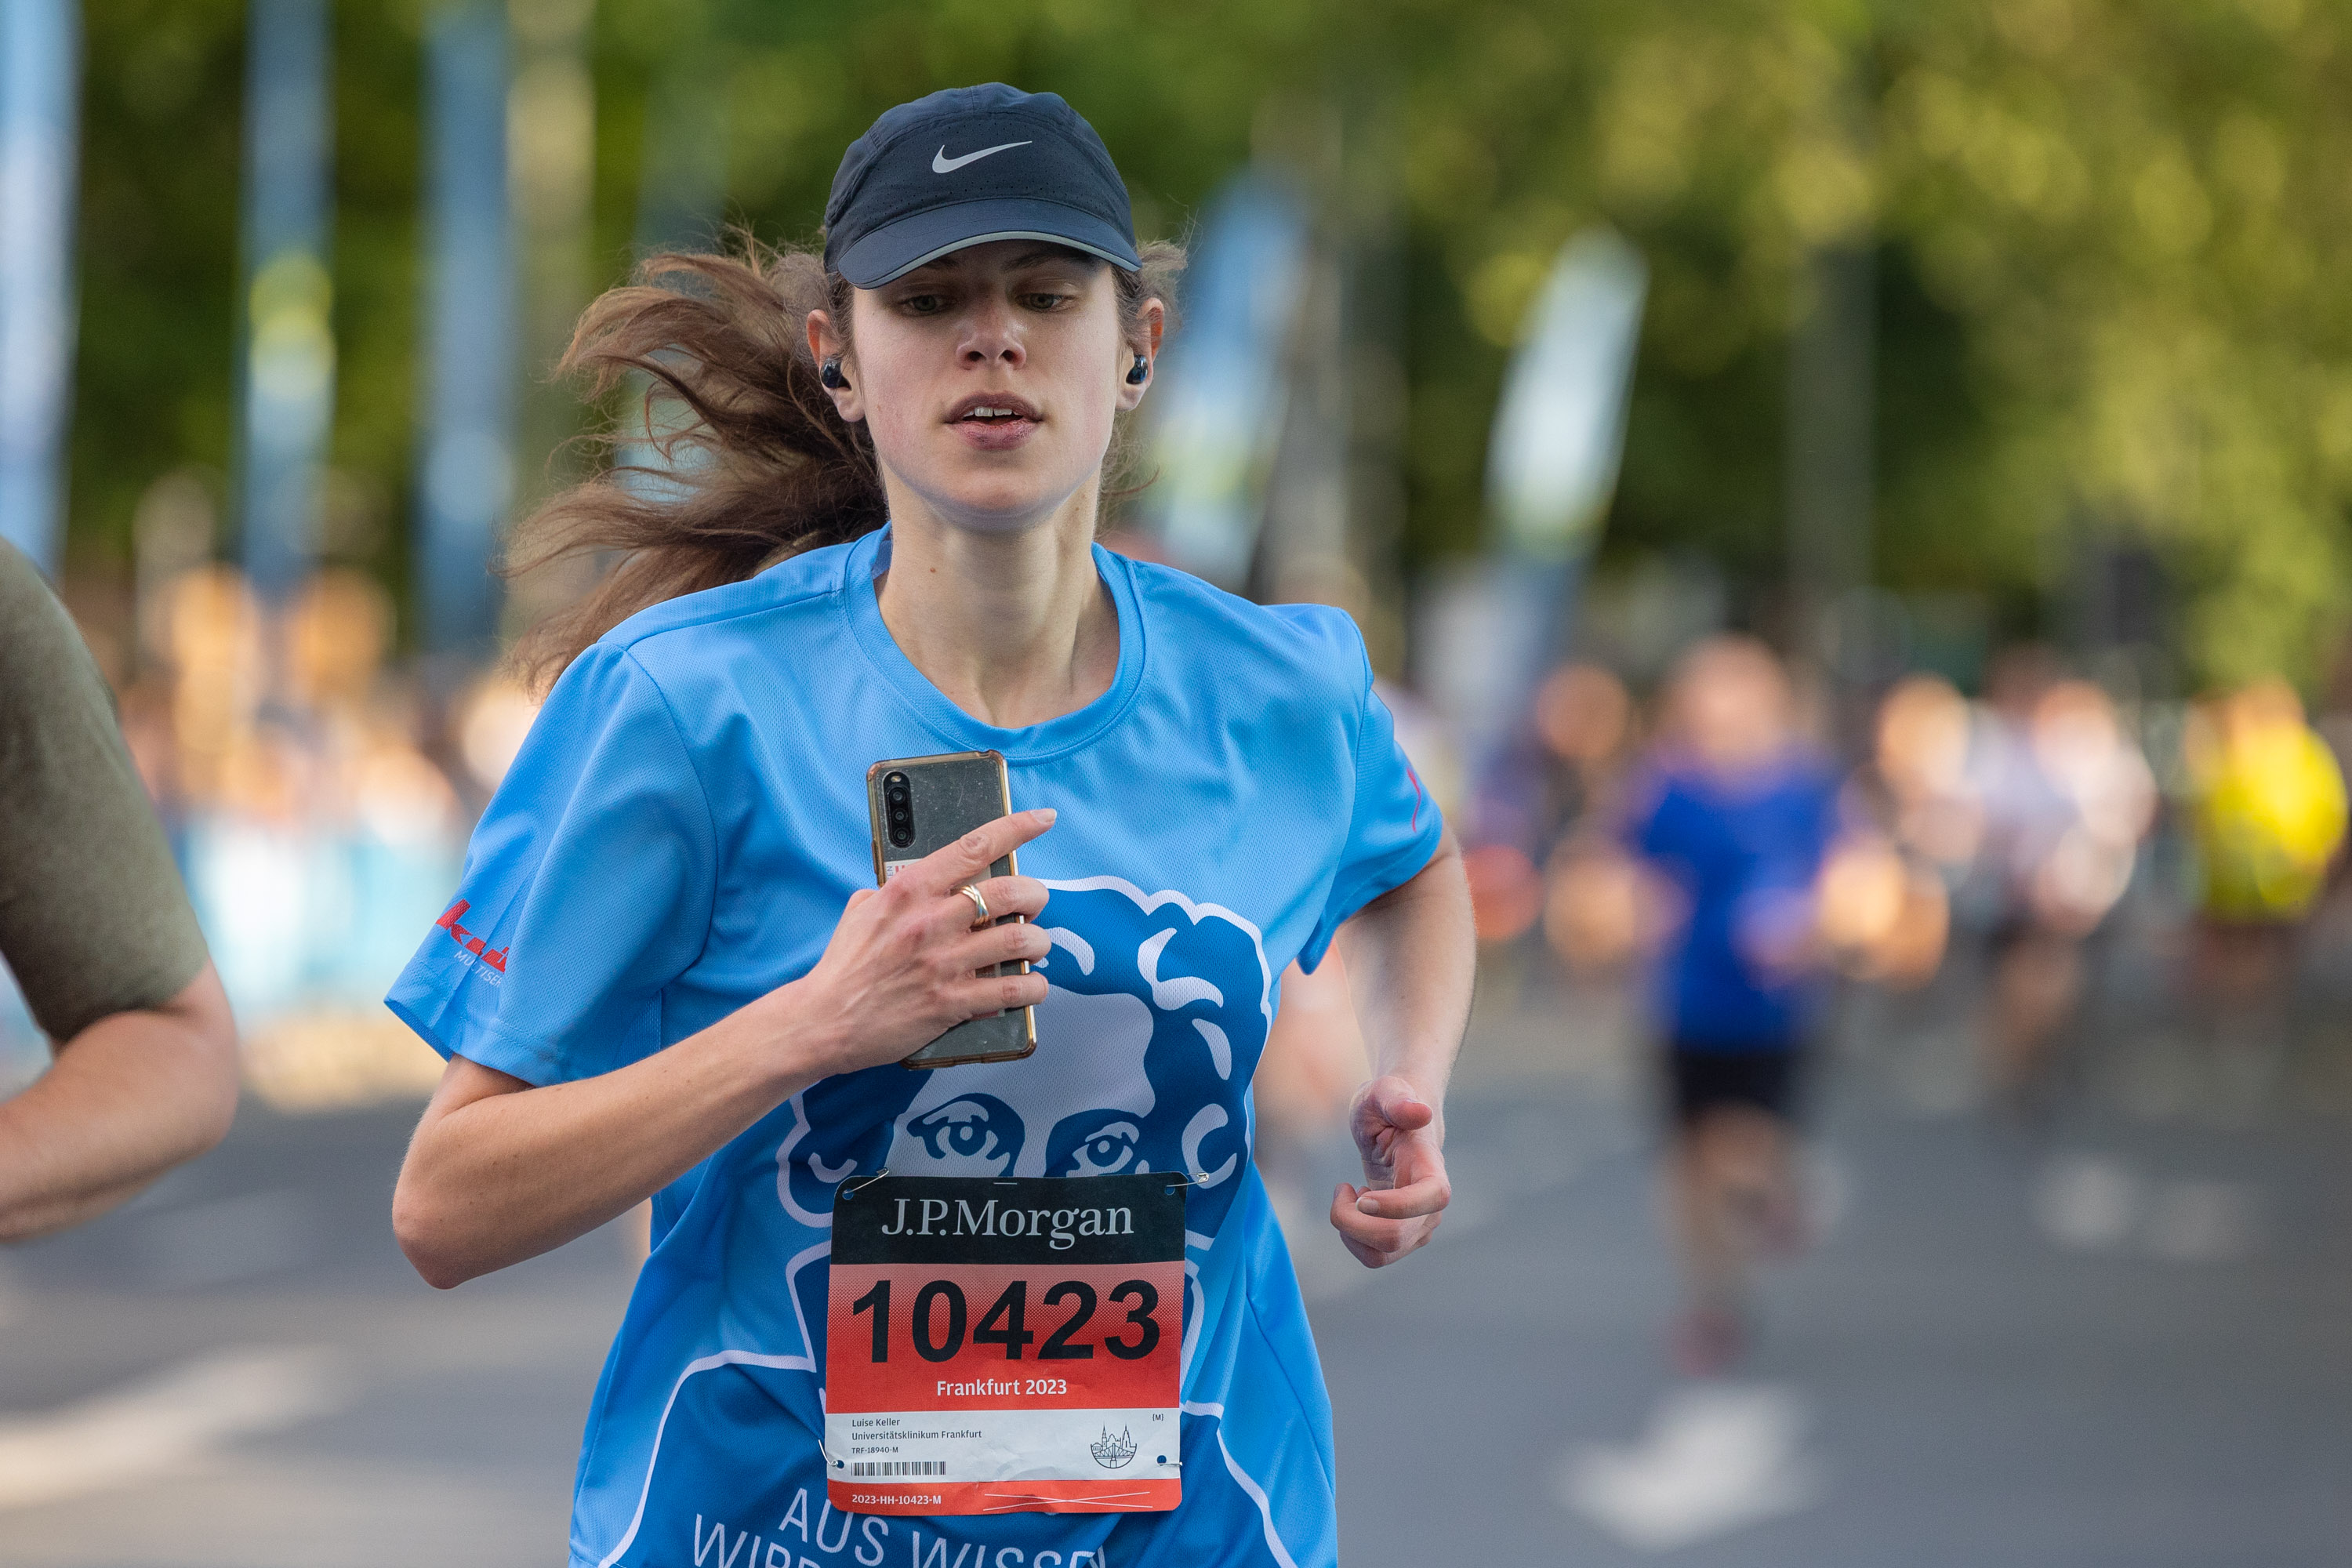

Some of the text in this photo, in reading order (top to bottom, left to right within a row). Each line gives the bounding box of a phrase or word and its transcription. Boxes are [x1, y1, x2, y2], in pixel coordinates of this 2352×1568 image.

[852, 1279, 1160, 1363] 10423
[937, 1378, 1067, 1396] Frankfurt 2023
[851, 1417, 901, 1428] Luise Keller
[851, 1429, 982, 1441] Universitätsklinikum Frankfurt
[851, 1494, 942, 1504] 2023-HH-10423-M
[778, 1487, 889, 1567] AUS
